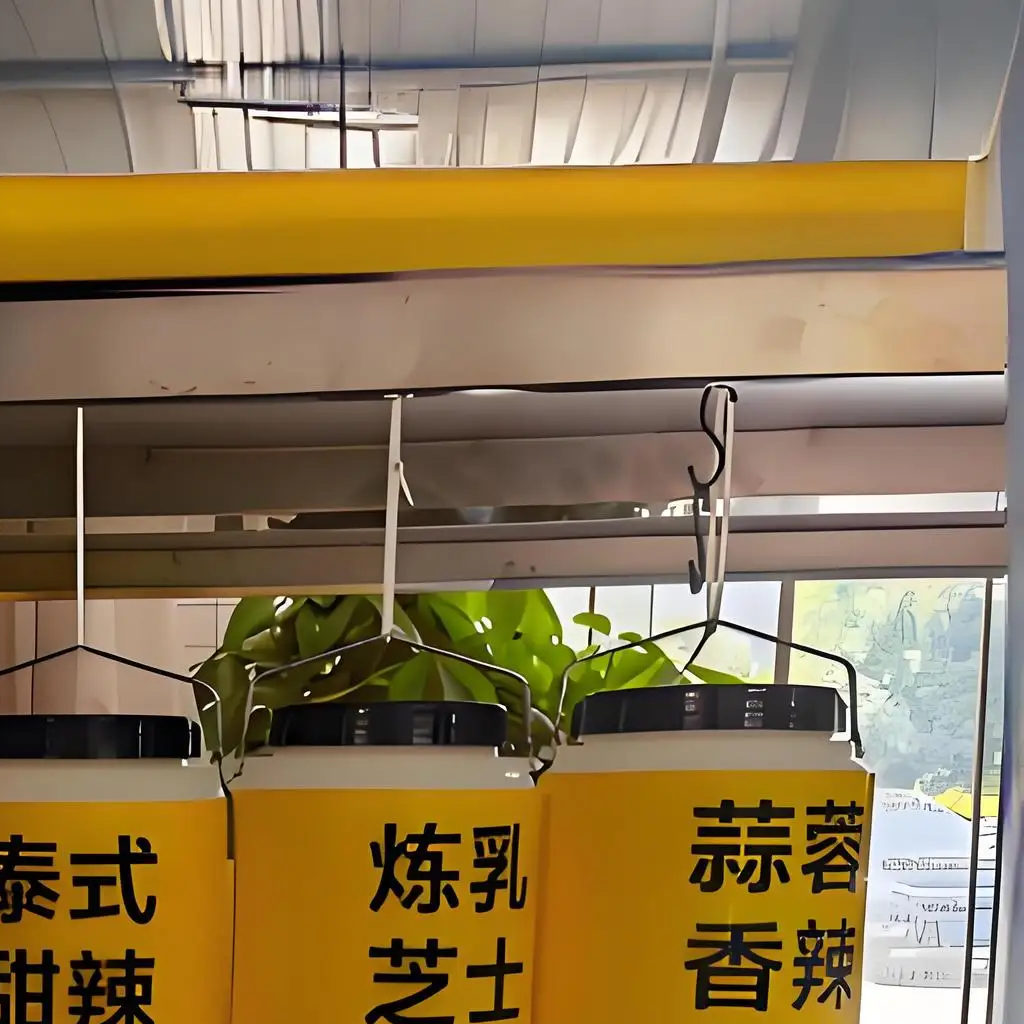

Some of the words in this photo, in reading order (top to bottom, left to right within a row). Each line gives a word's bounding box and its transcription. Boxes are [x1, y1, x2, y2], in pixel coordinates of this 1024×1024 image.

[369, 822, 528, 913] 炼乳
[688, 799, 864, 893] 蒜蓉
[684, 917, 856, 1011] 香辣
